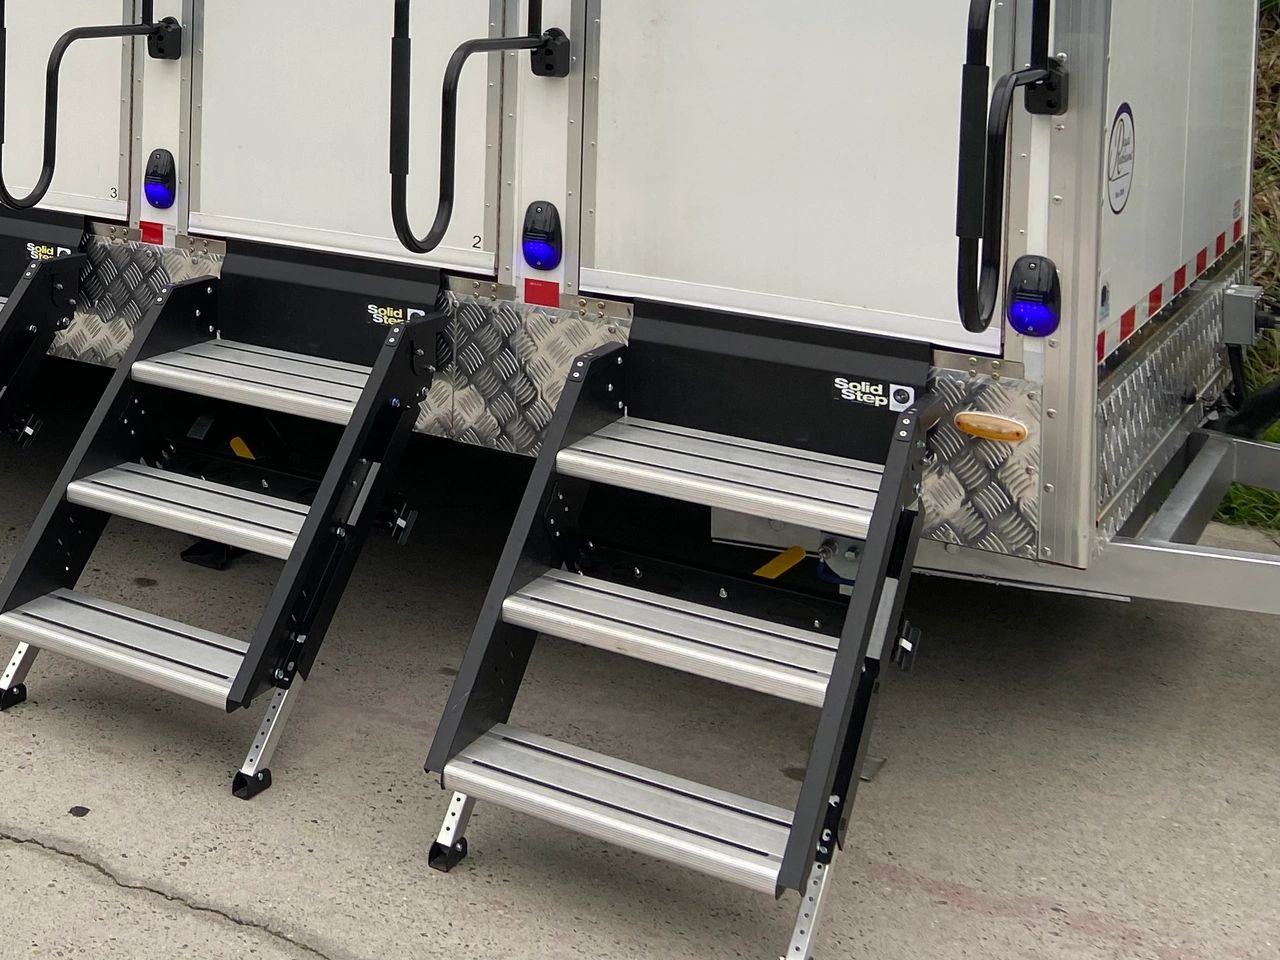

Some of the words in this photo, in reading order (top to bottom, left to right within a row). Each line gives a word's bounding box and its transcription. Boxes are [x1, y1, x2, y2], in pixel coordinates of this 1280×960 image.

[110, 187, 117, 198] 3
[26, 242, 54, 255] Solid
[472, 235, 482, 249] 2
[367, 304, 403, 318] Solid
[833, 377, 883, 396] Solid
[841, 388, 888, 407] Step
